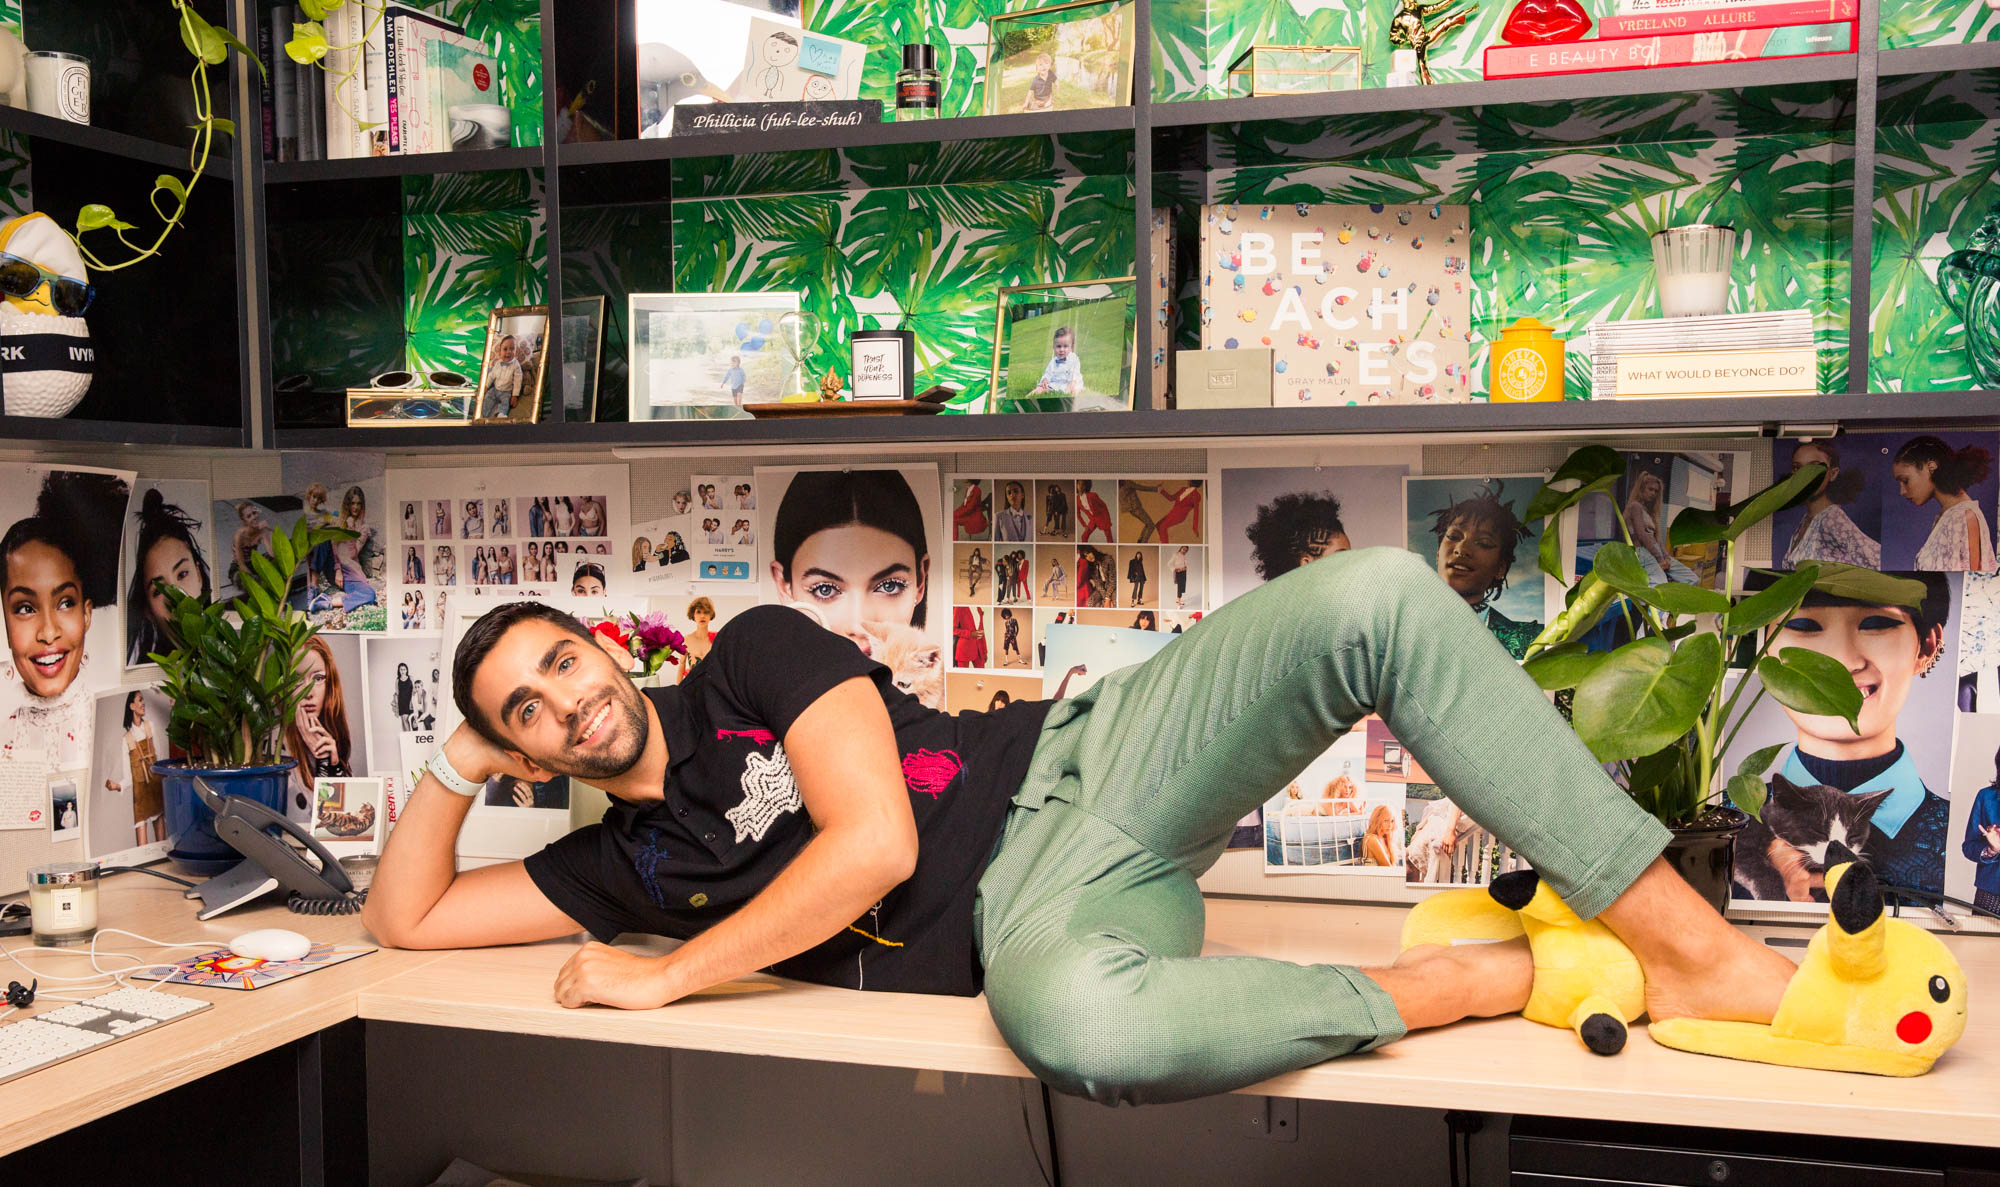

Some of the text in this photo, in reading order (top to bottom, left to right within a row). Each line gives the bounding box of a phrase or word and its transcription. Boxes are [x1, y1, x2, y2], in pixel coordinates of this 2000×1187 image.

[1619, 11, 1757, 32] VREELAND ALLURE
[386, 16, 398, 94] AMY POEHLER
[1549, 48, 1619, 65] BEAUTY
[389, 98, 400, 147] YES PLEASE
[693, 111, 863, 132] Phillicia (fuh-lee-shuh)
[1239, 231, 1325, 276] BE
[1268, 285, 1409, 331] ACH
[1358, 340, 1438, 385] ES
[1628, 366, 1806, 381] WHAT WOULD BEYONCE DO?
[1287, 377, 1352, 386] GRAY MALIN
